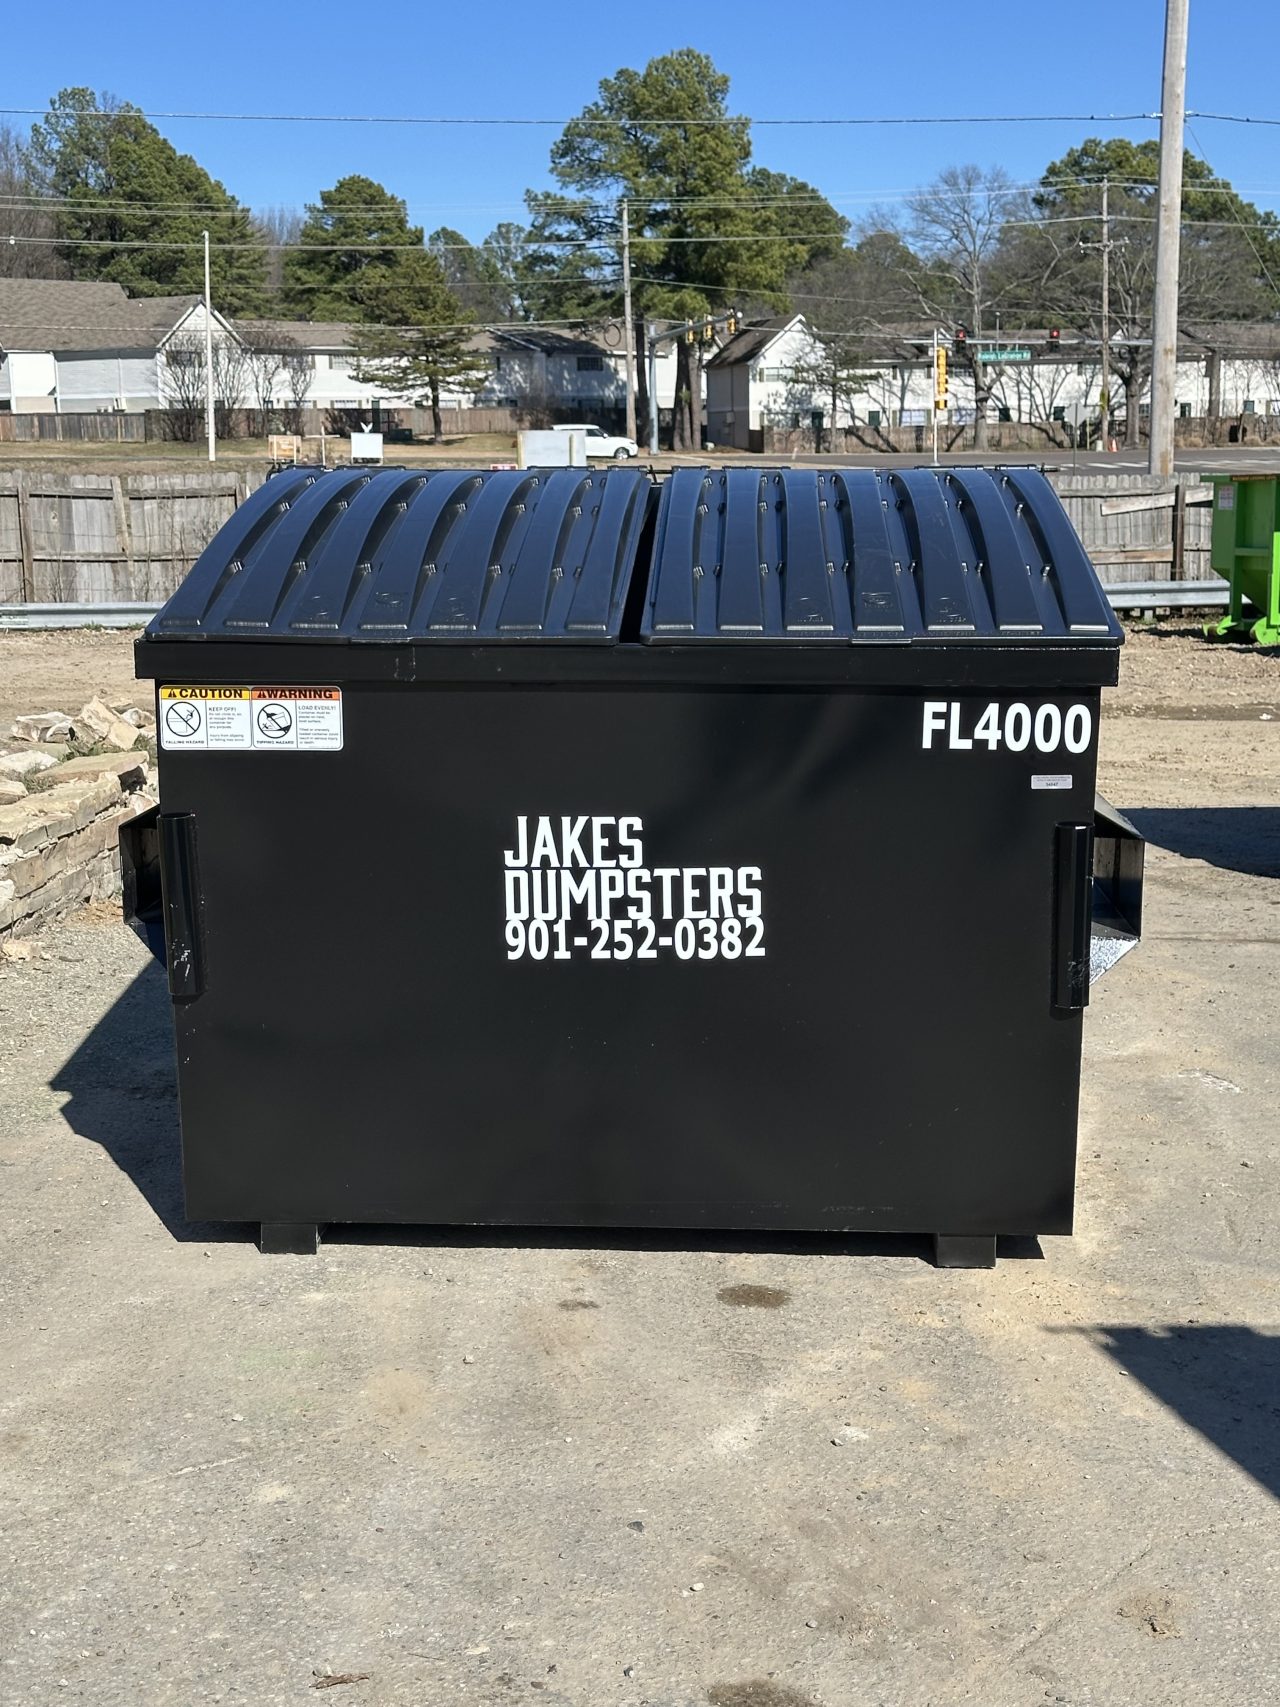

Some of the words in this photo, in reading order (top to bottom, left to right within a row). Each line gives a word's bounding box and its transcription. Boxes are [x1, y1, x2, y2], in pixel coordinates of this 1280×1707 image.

[179, 688, 243, 699] CAUTION
[267, 689, 333, 699] WARNING
[922, 701, 1092, 754] FL4000
[504, 816, 643, 868] JAKES
[504, 866, 762, 920] DUMPSTERS
[505, 917, 766, 960] 901-252-0382
